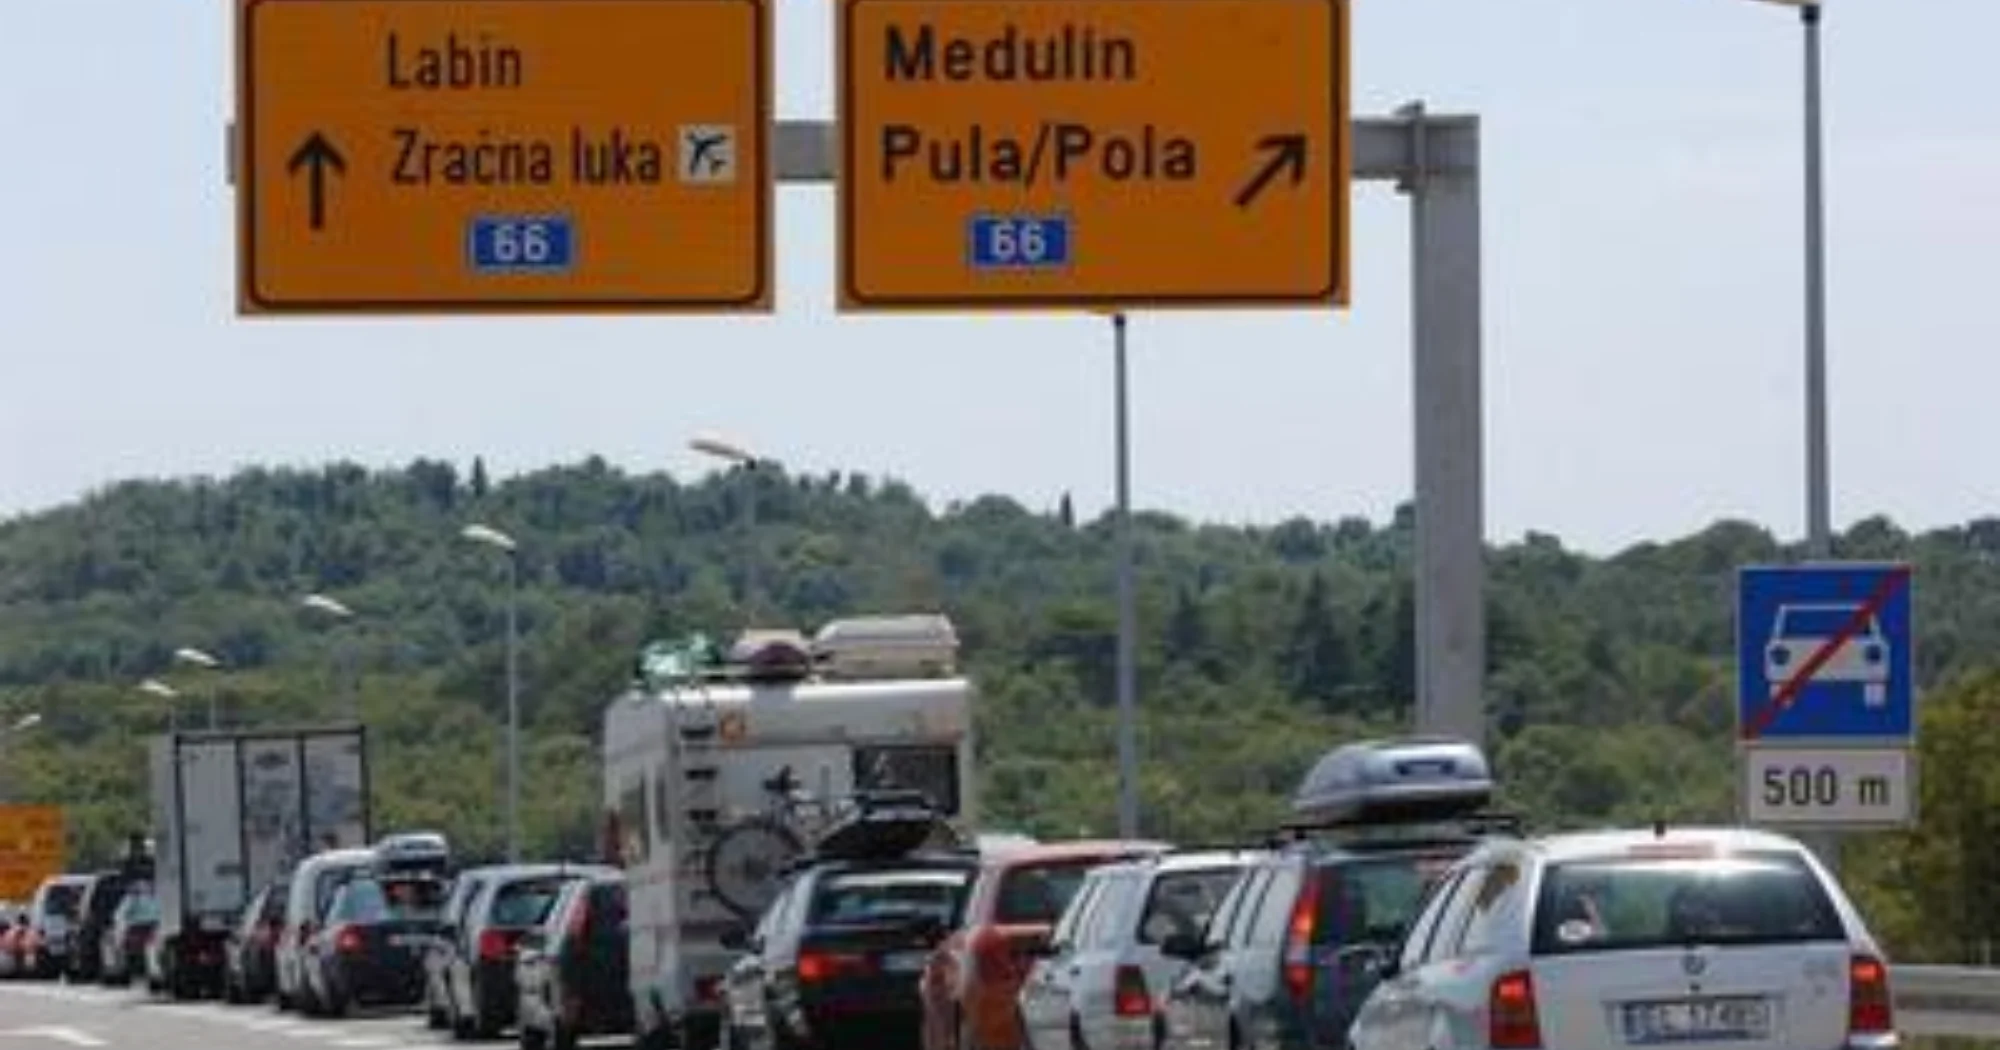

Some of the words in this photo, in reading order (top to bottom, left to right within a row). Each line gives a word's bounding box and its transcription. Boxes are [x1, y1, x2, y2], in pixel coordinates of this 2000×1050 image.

[387, 32, 522, 88] Labin
[885, 25, 1136, 81] Medulin
[571, 126, 661, 184] luka
[882, 122, 1197, 188] Pula/Pola
[493, 224, 549, 262] 66
[989, 221, 1046, 259] 66
[1763, 766, 1837, 805] 500
[1858, 776, 1889, 805] m
